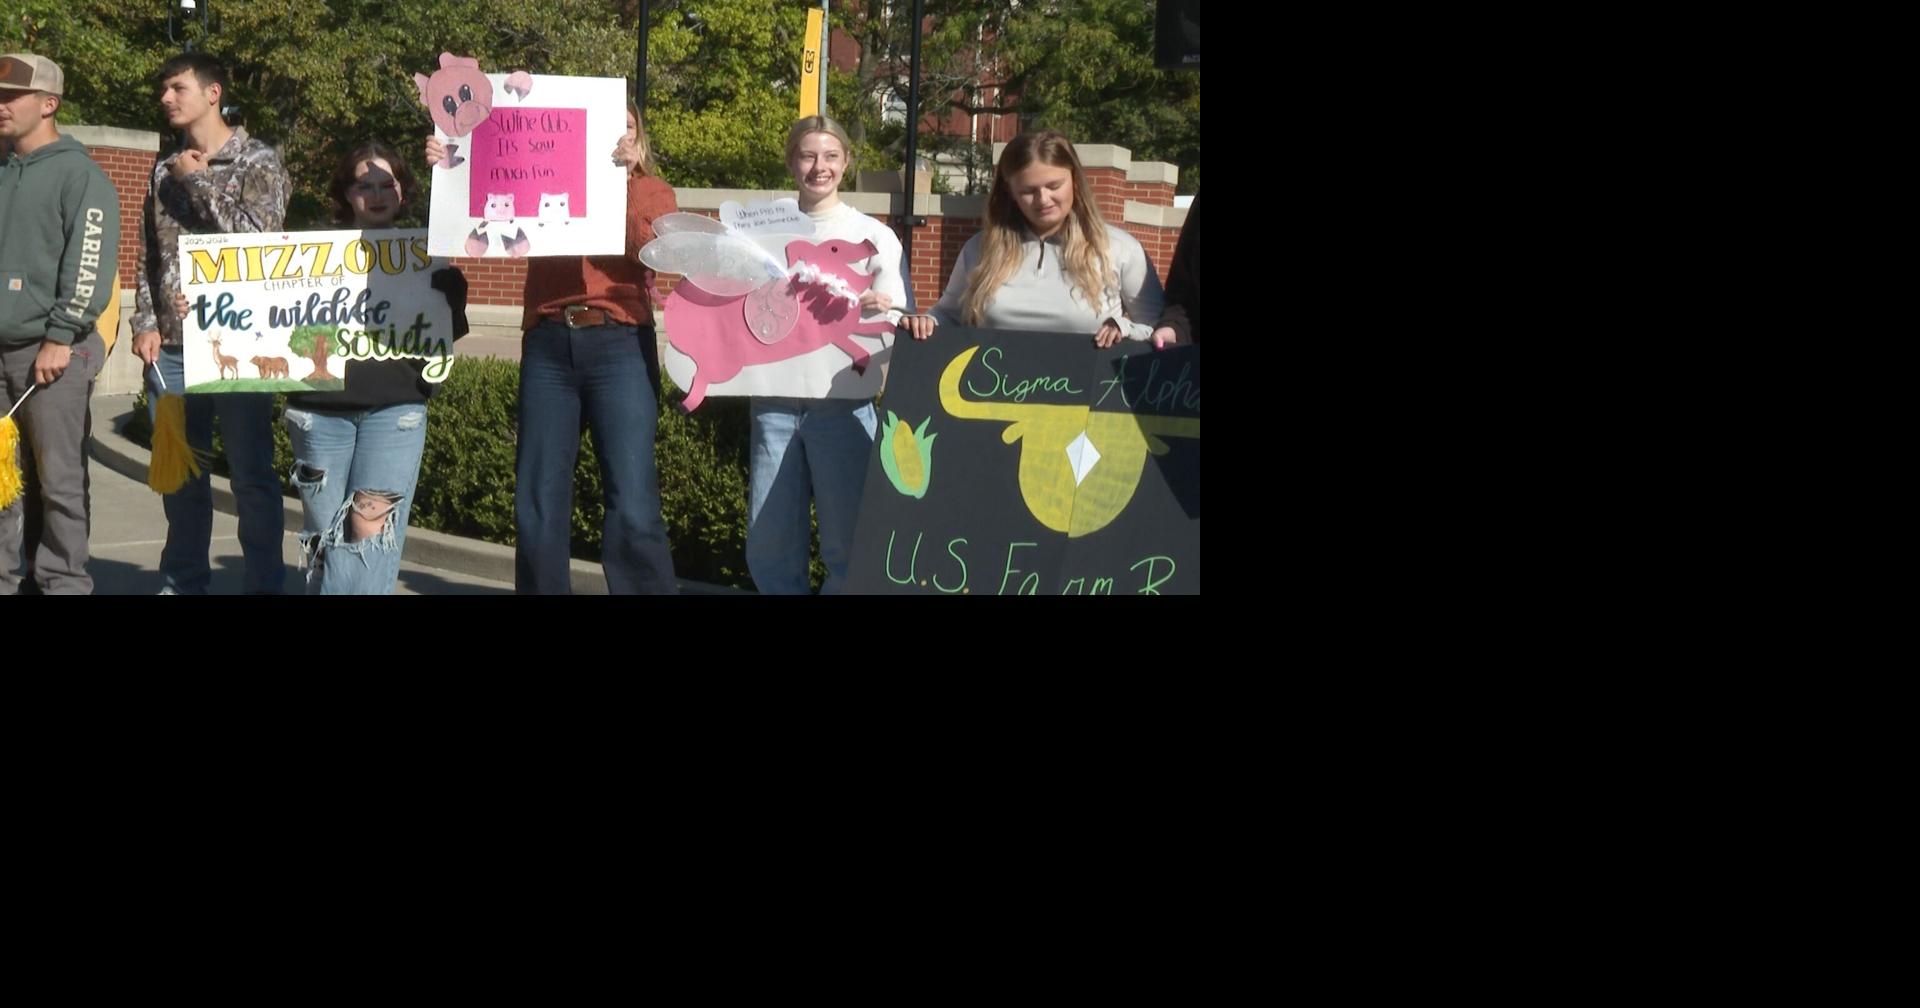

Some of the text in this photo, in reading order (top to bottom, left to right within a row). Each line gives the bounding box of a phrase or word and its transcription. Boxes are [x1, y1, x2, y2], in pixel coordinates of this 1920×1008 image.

[65, 208, 104, 318] CARHARTT
[187, 237, 432, 285] MIZZOU'S
[263, 276, 346, 292] CHAPTER OF
[189, 292, 253, 331] the
[335, 312, 453, 378] society
[966, 347, 1083, 402] Sigma
[885, 530, 970, 594] U.S.
